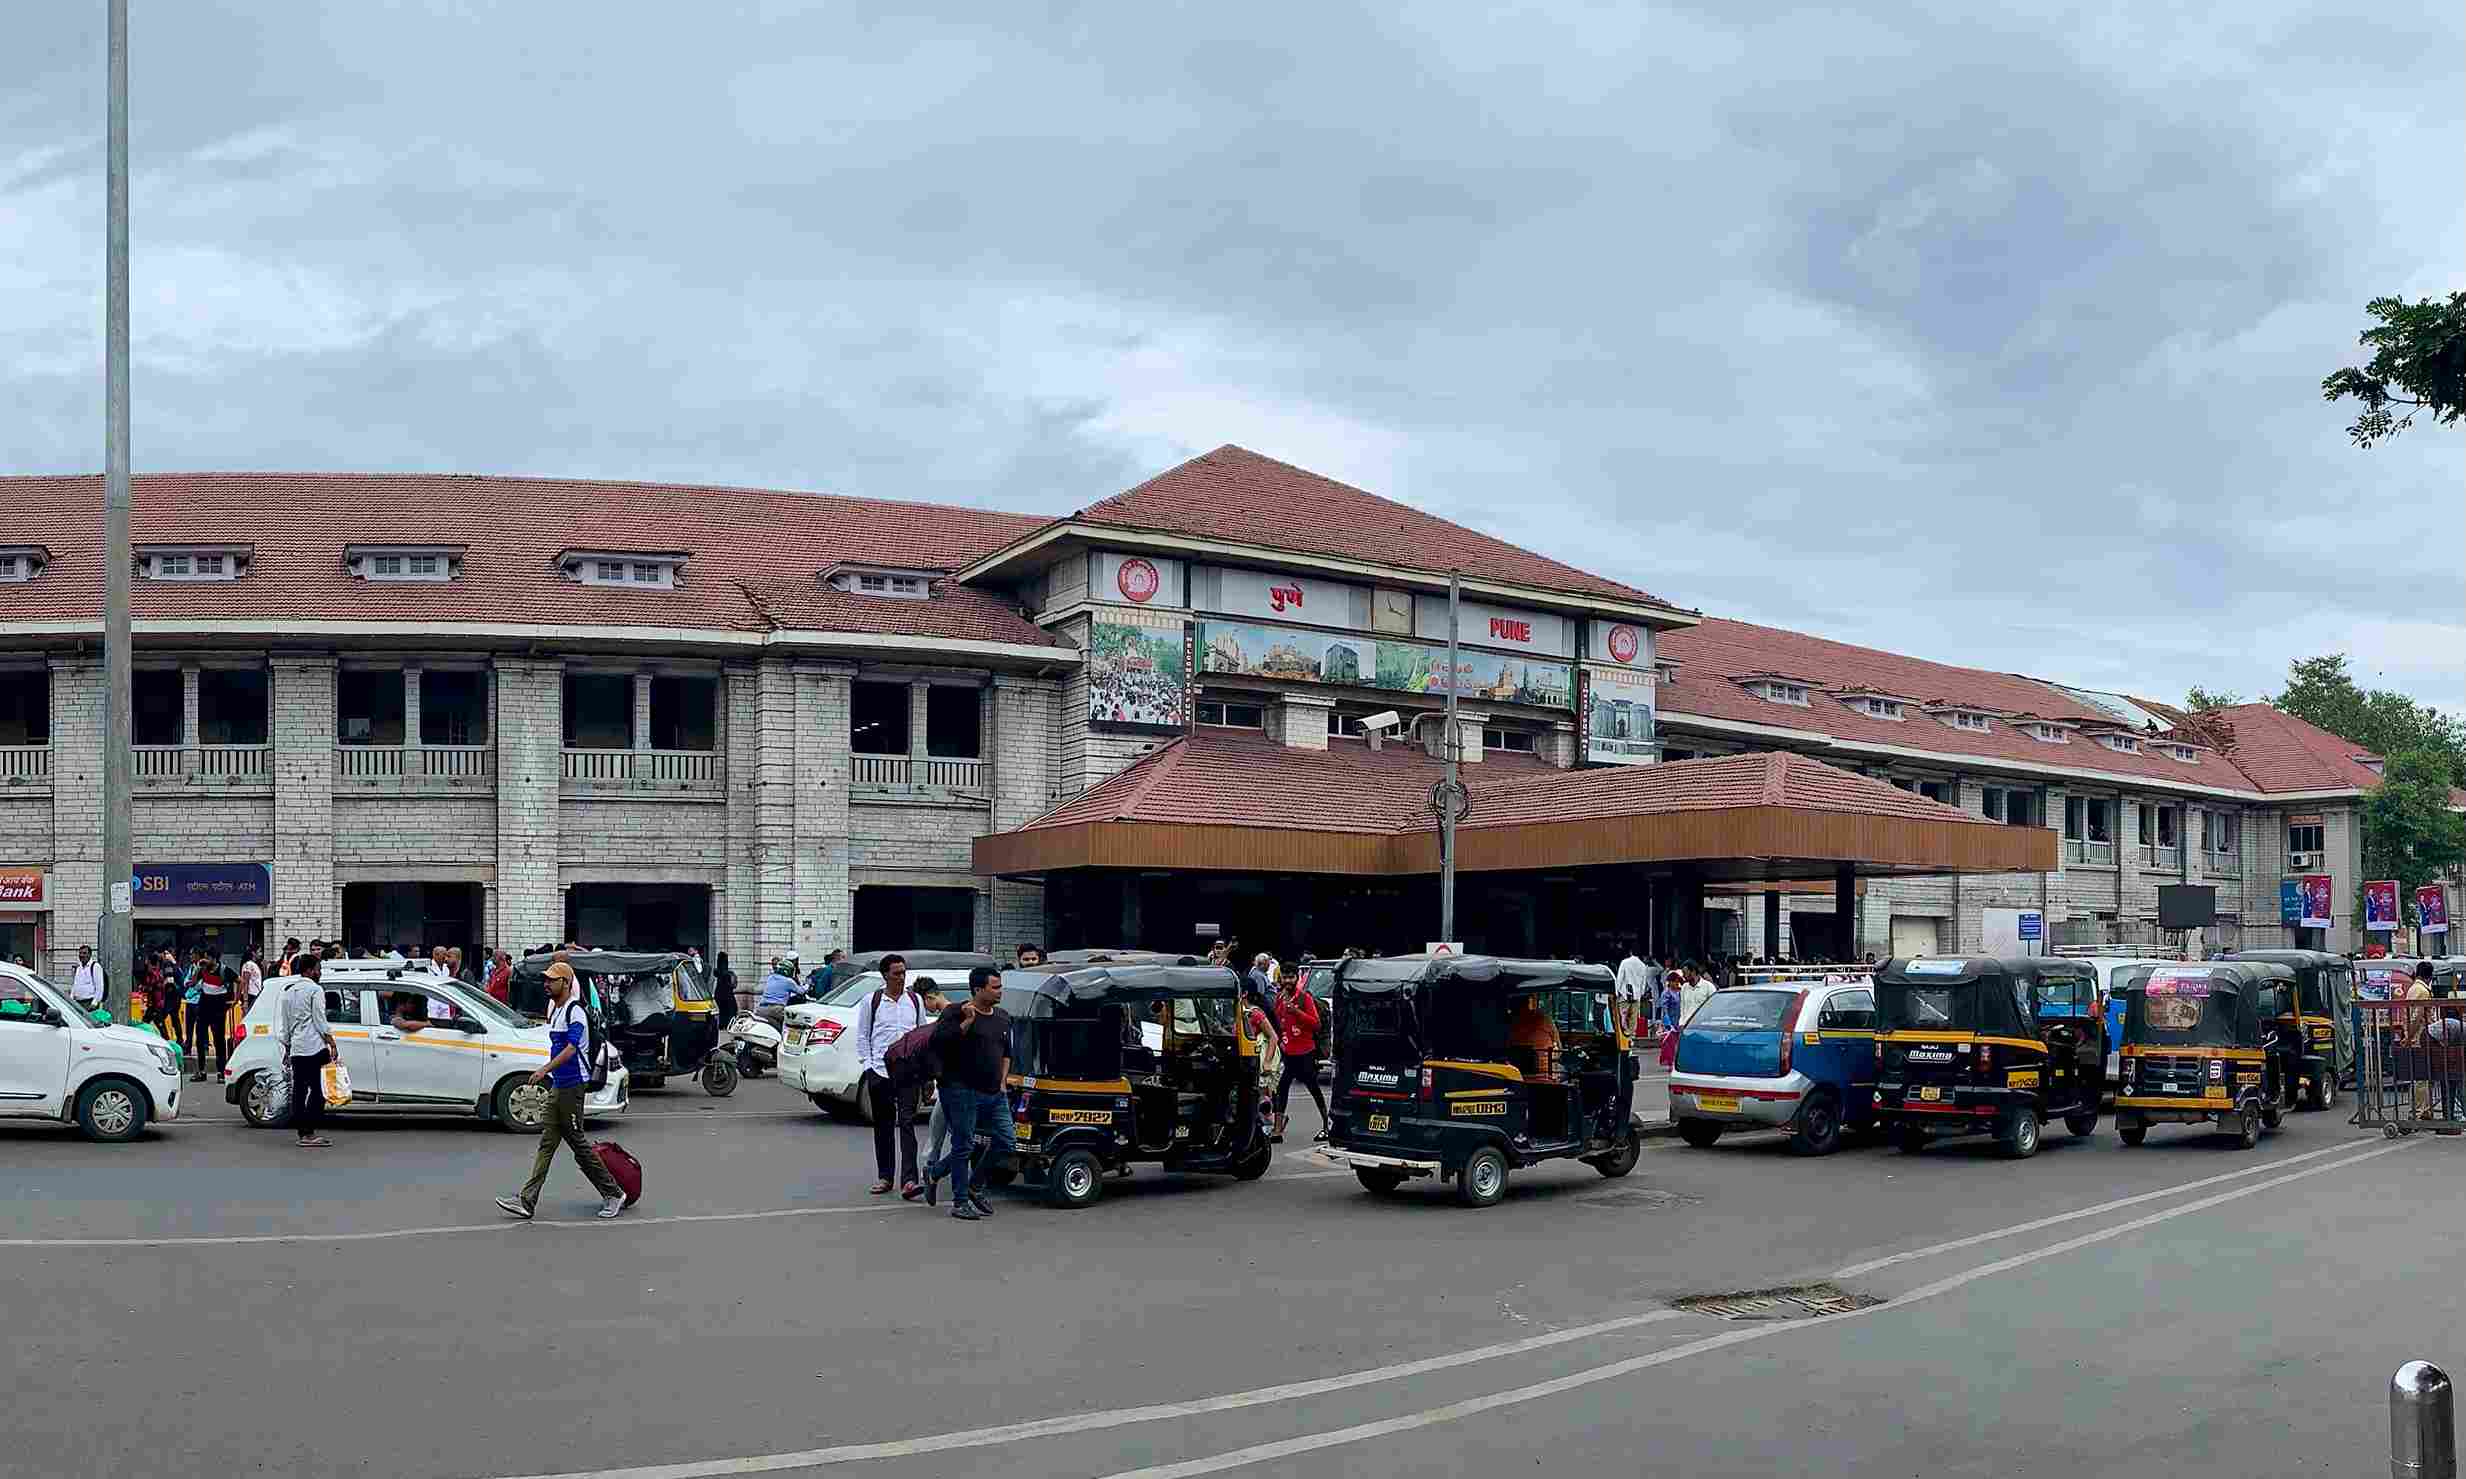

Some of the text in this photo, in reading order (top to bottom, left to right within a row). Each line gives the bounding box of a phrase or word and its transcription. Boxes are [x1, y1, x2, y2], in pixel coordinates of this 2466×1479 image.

[1270, 583, 1304, 612] पुणे
[1489, 617, 1531, 642] PUNE
[143, 876, 169, 892] SBI
